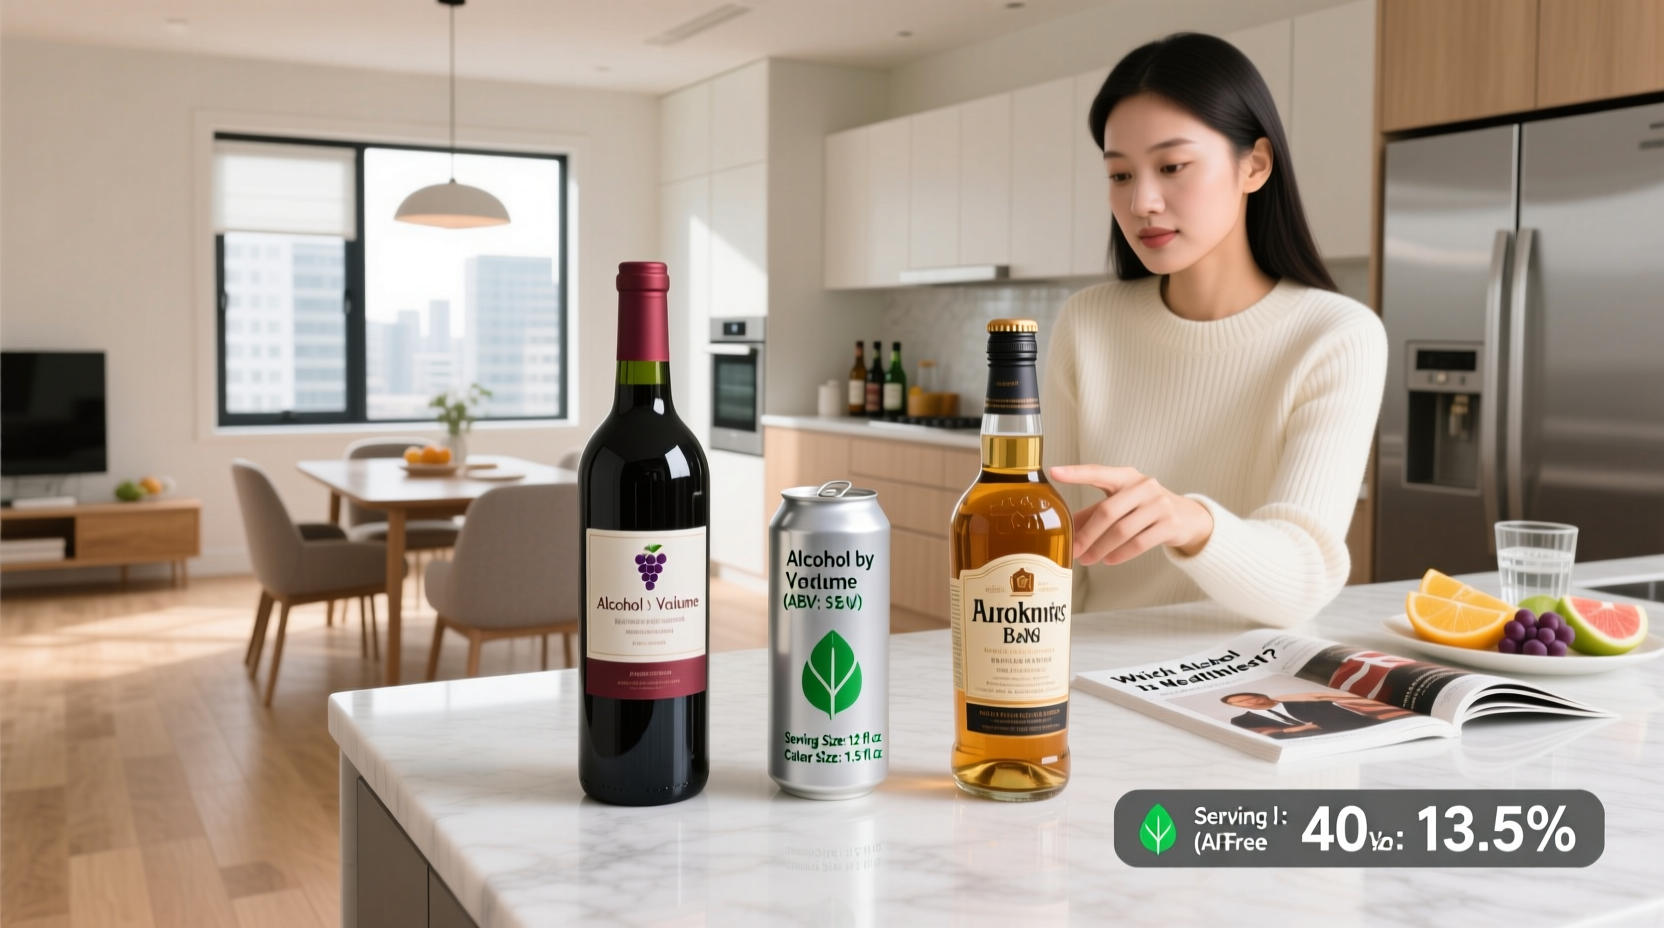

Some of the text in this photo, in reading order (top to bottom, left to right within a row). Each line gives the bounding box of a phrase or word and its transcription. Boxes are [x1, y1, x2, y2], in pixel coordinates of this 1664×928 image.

[786, 549, 875, 571] Alcohol by
[596, 595, 643, 612] Alcohol
[849, 733, 860, 746] 12
[844, 750, 861, 763] 1.5
